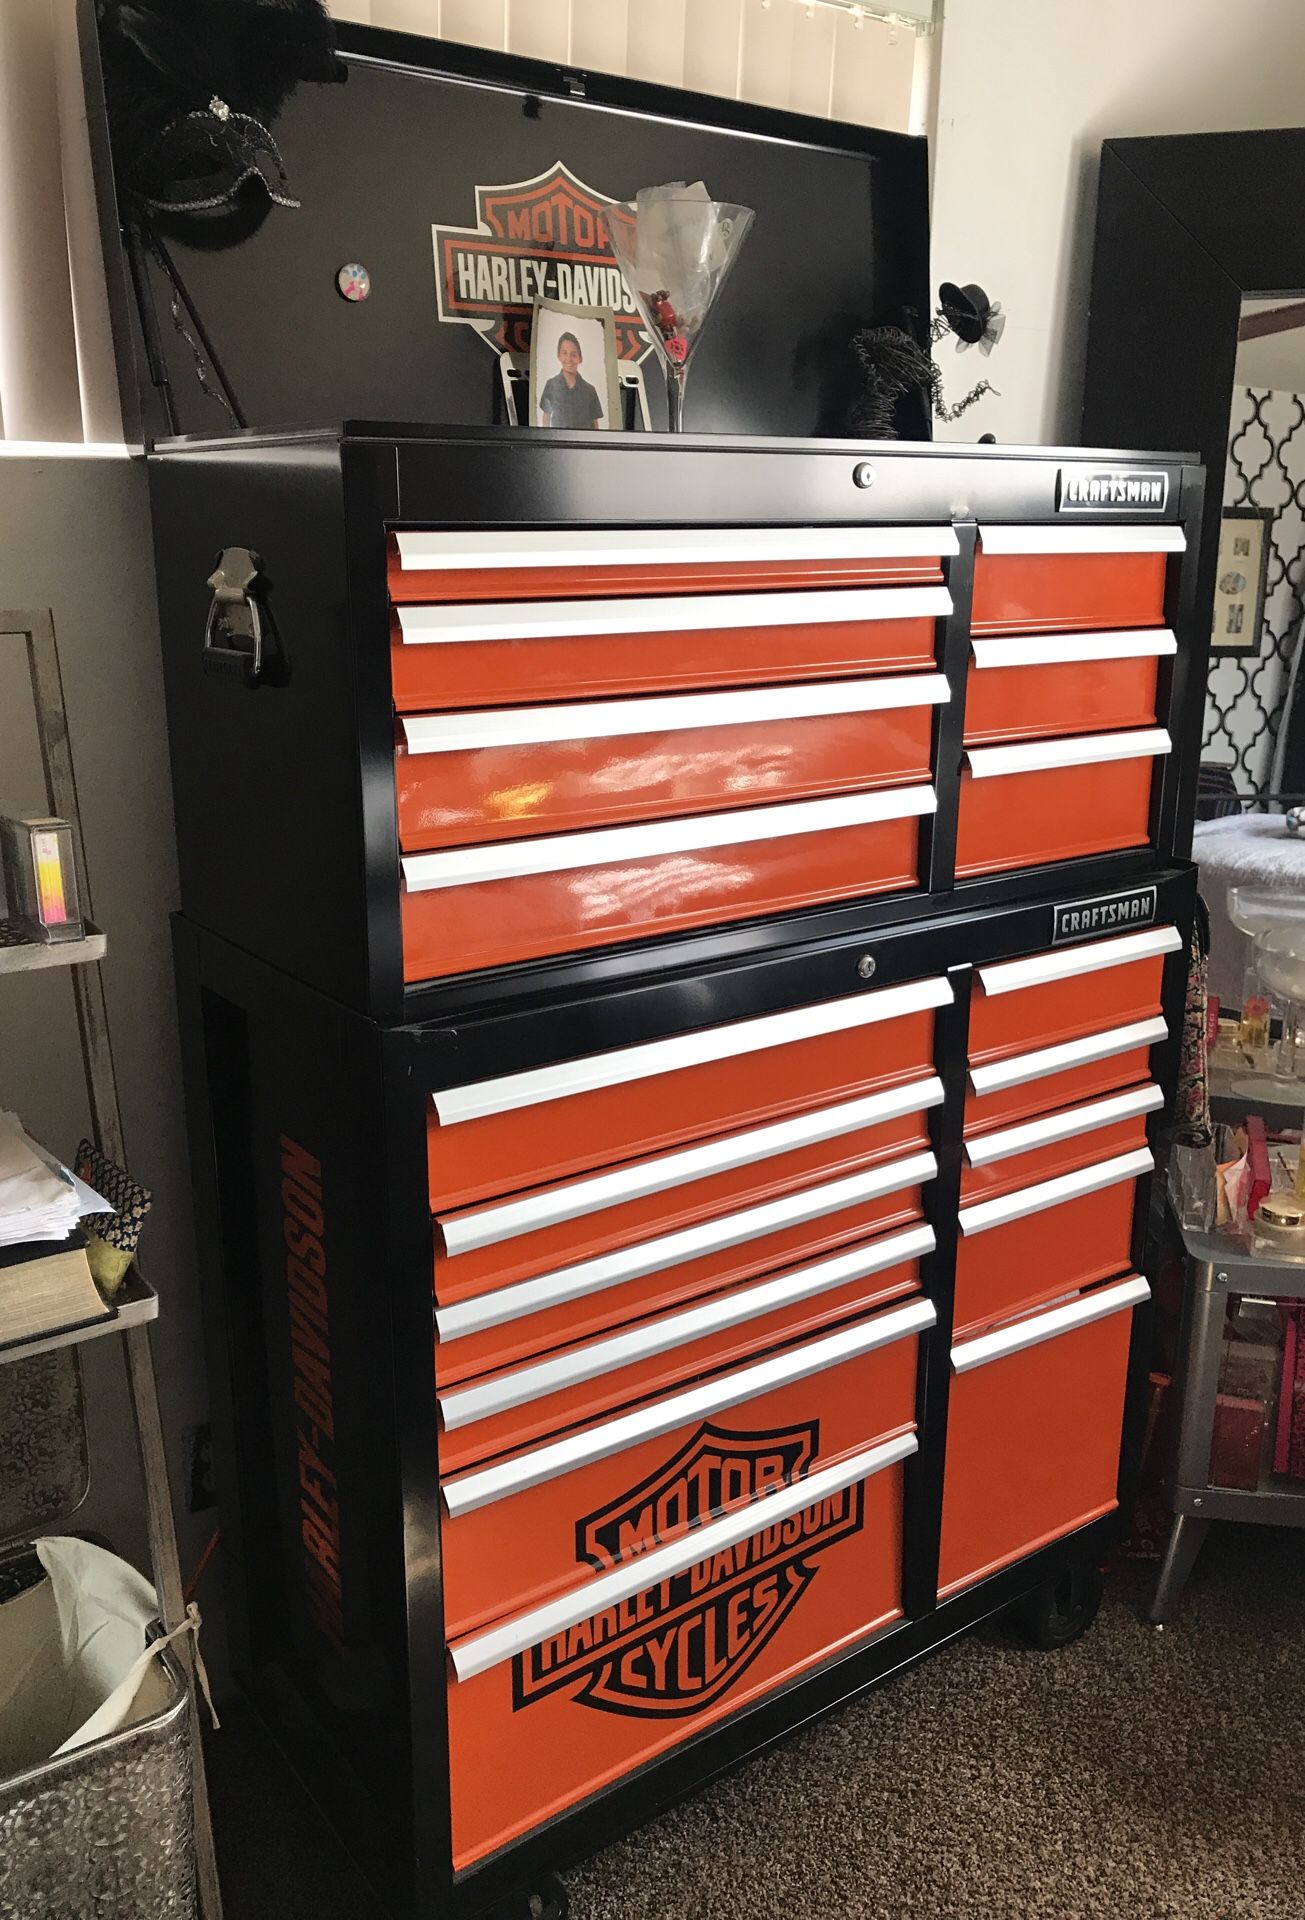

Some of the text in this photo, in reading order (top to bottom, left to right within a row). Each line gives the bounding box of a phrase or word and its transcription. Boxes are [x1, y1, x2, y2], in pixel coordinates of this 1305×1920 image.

[457, 252, 638, 314] HARLEY-DAVIDS
[1068, 479, 1161, 502] CRAFTSMAN
[1061, 897, 1150, 933] CRAFTSMAN
[280, 1132, 344, 1648] RLEY-DAVIDSON
[619, 1454, 787, 1557] MOTOR
[620, 1573, 778, 1691] CYCLES
